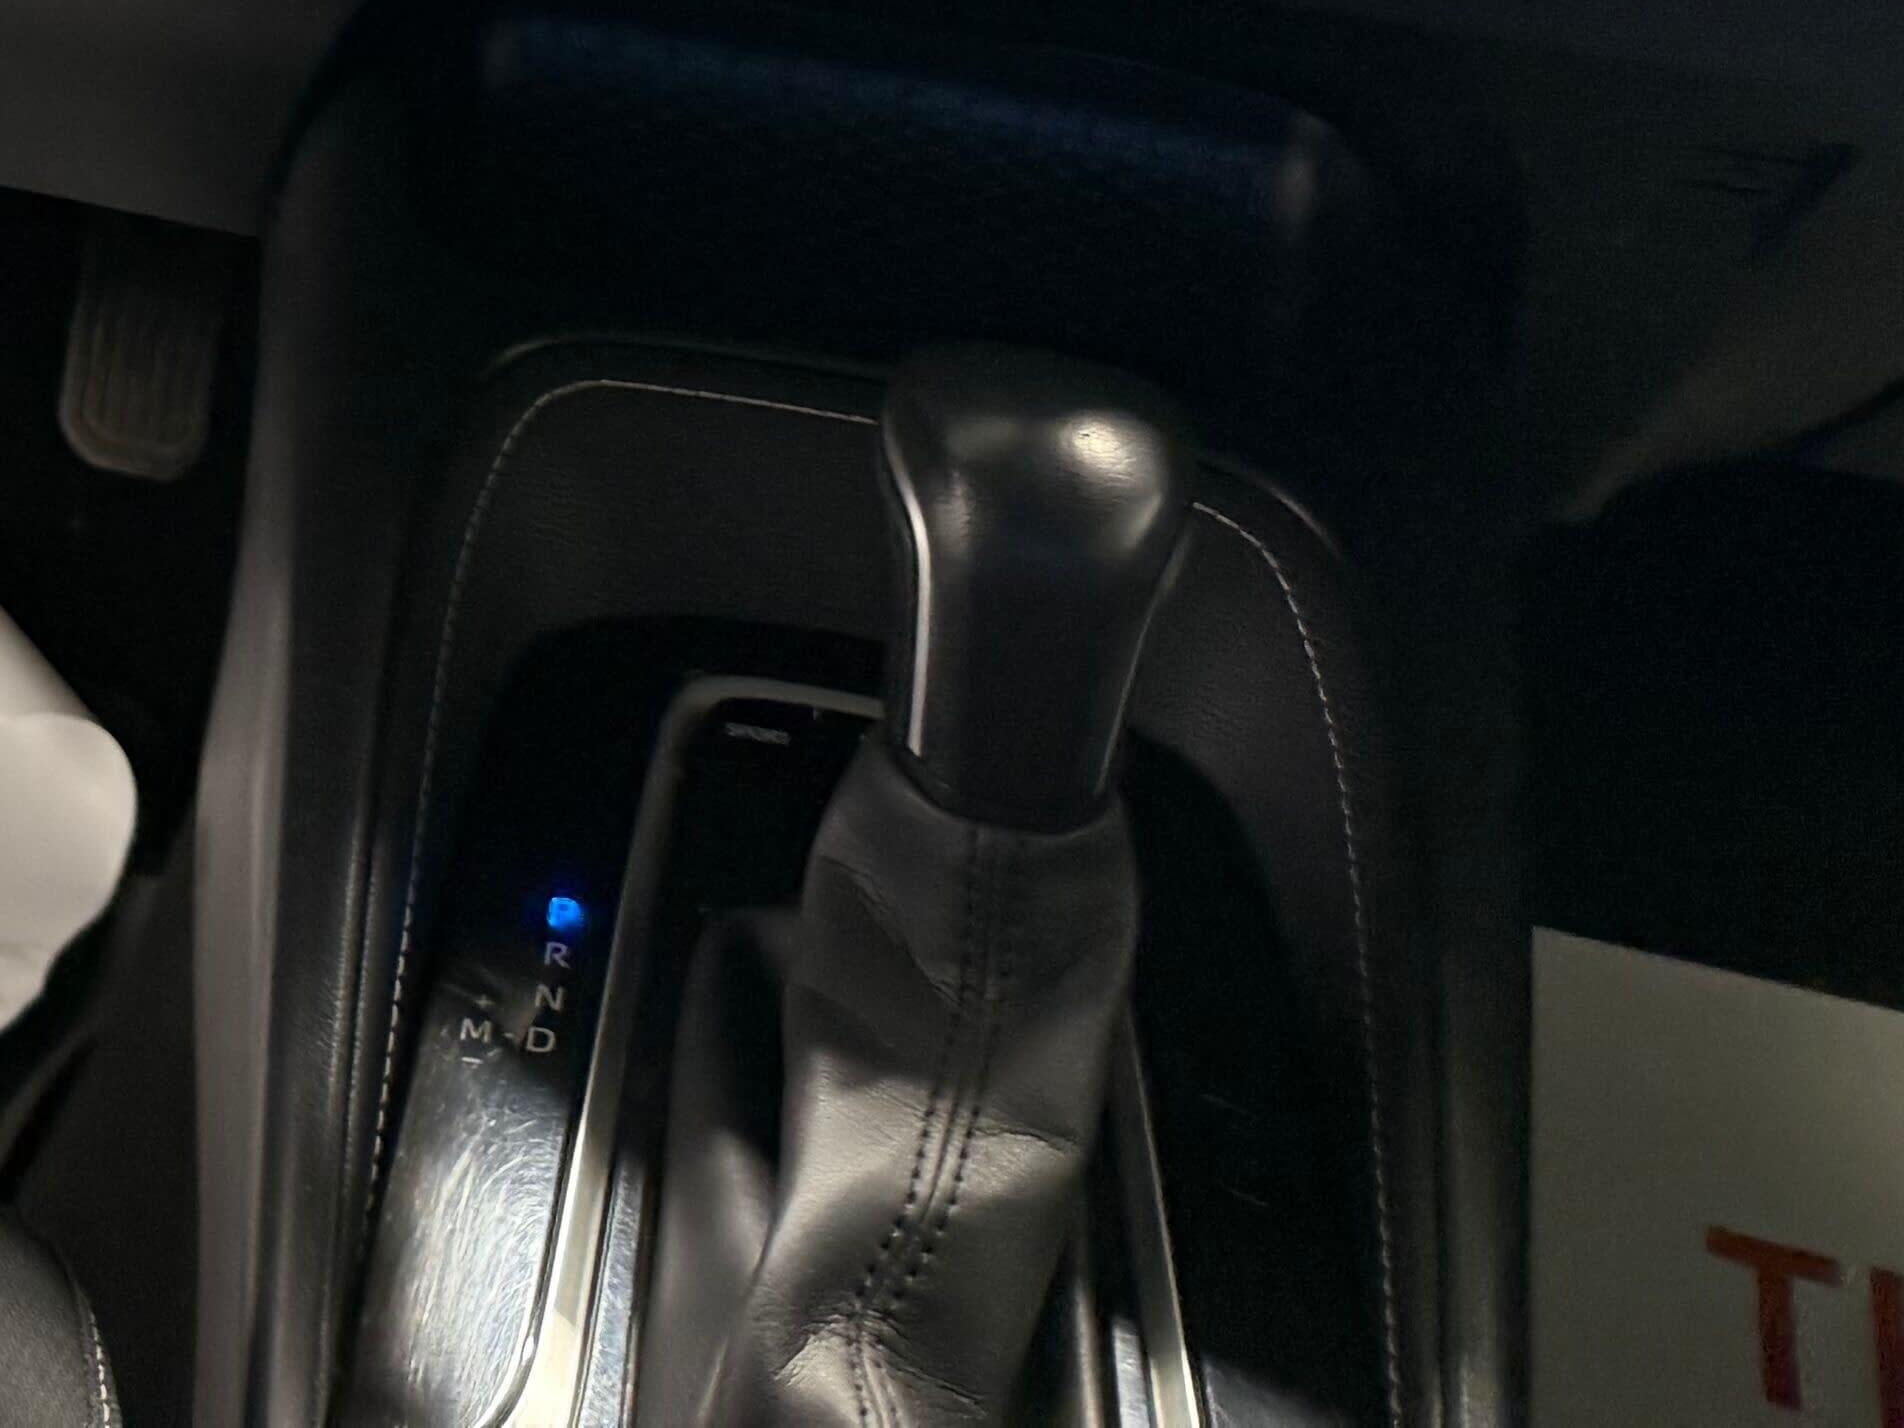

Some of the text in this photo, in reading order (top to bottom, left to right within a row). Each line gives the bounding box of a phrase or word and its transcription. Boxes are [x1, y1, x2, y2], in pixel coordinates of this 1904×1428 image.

[545, 896, 583, 930] P
[543, 941, 571, 969] R
[534, 983, 566, 1012] N
[458, 1016, 558, 1053] M D
